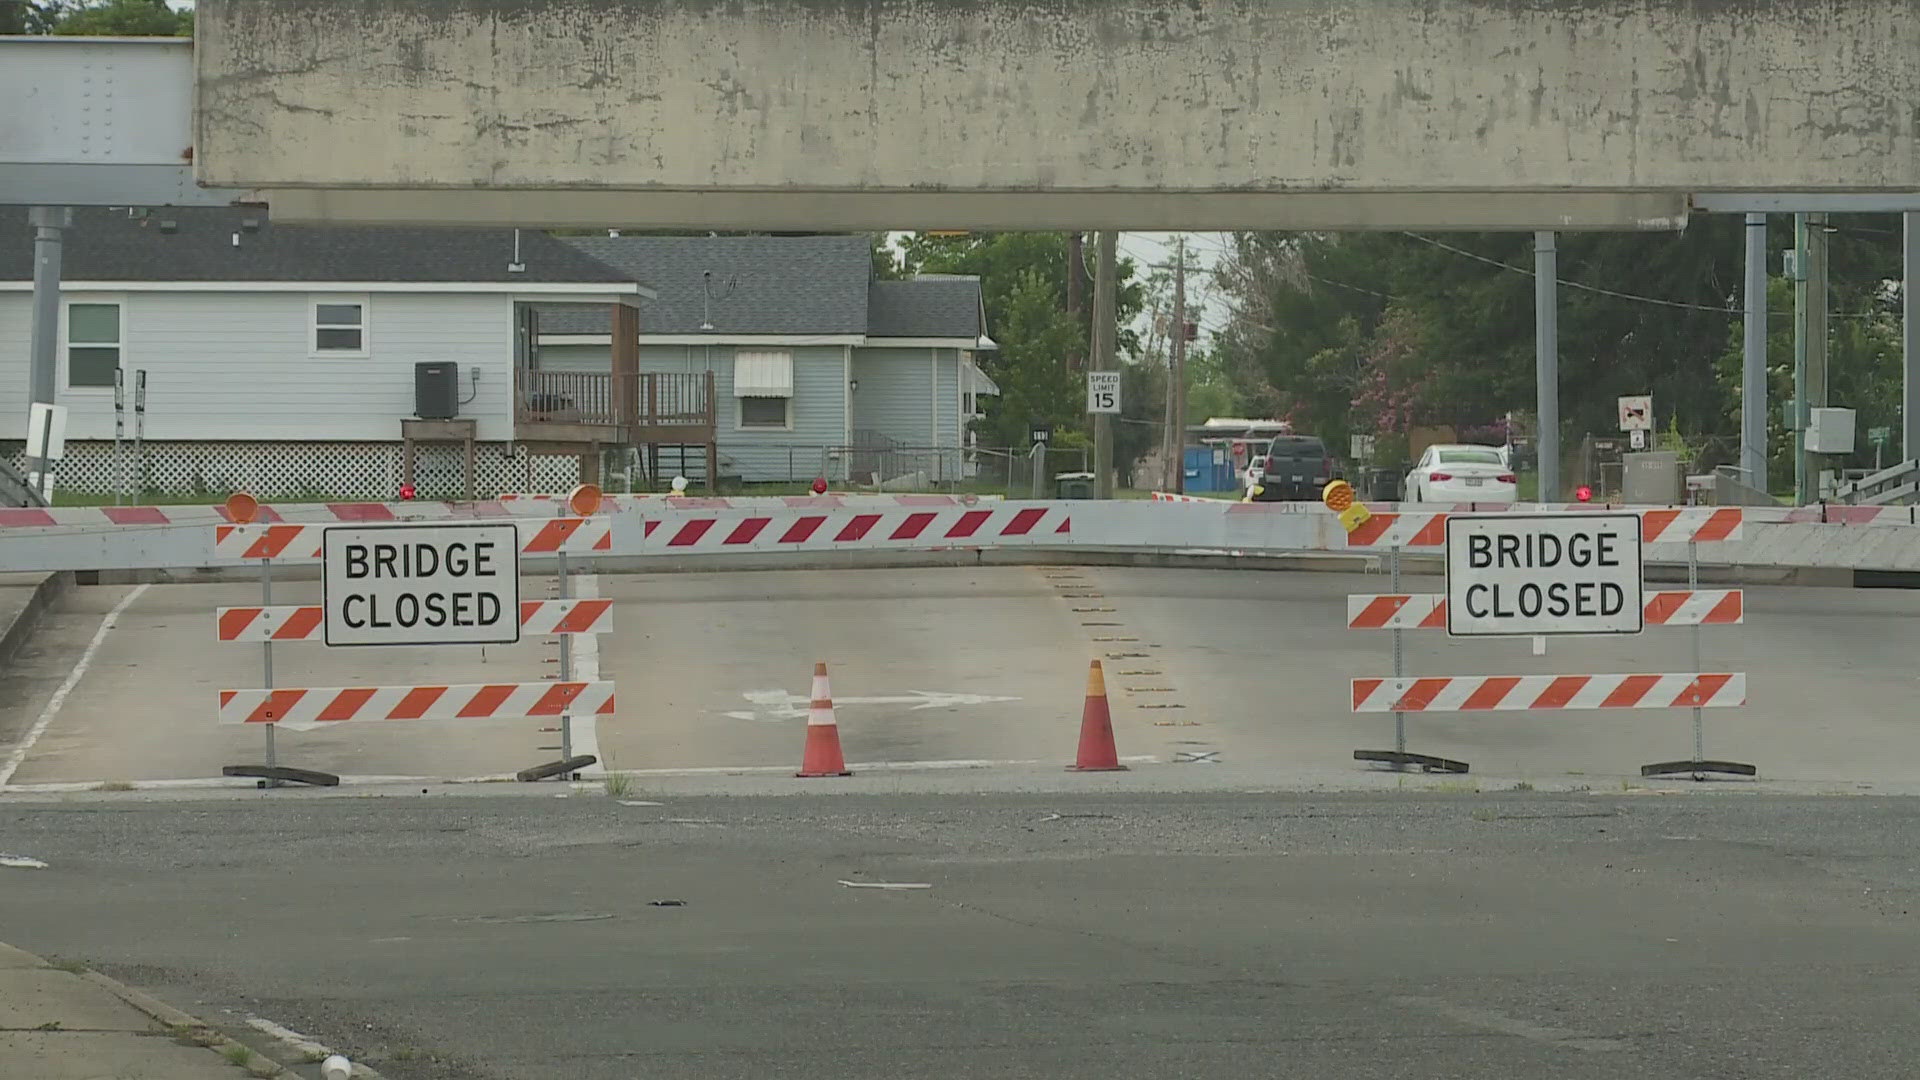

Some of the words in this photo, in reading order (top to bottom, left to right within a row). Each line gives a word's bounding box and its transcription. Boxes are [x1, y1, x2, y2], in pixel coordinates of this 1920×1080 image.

[1090, 375, 1119, 383] SPEED
[1095, 393, 1114, 408] 15
[345, 542, 496, 579] BRIDGE
[1468, 532, 1619, 568] BRIDGE
[342, 592, 501, 628] CLOSED
[1465, 582, 1624, 618] CLOSED
